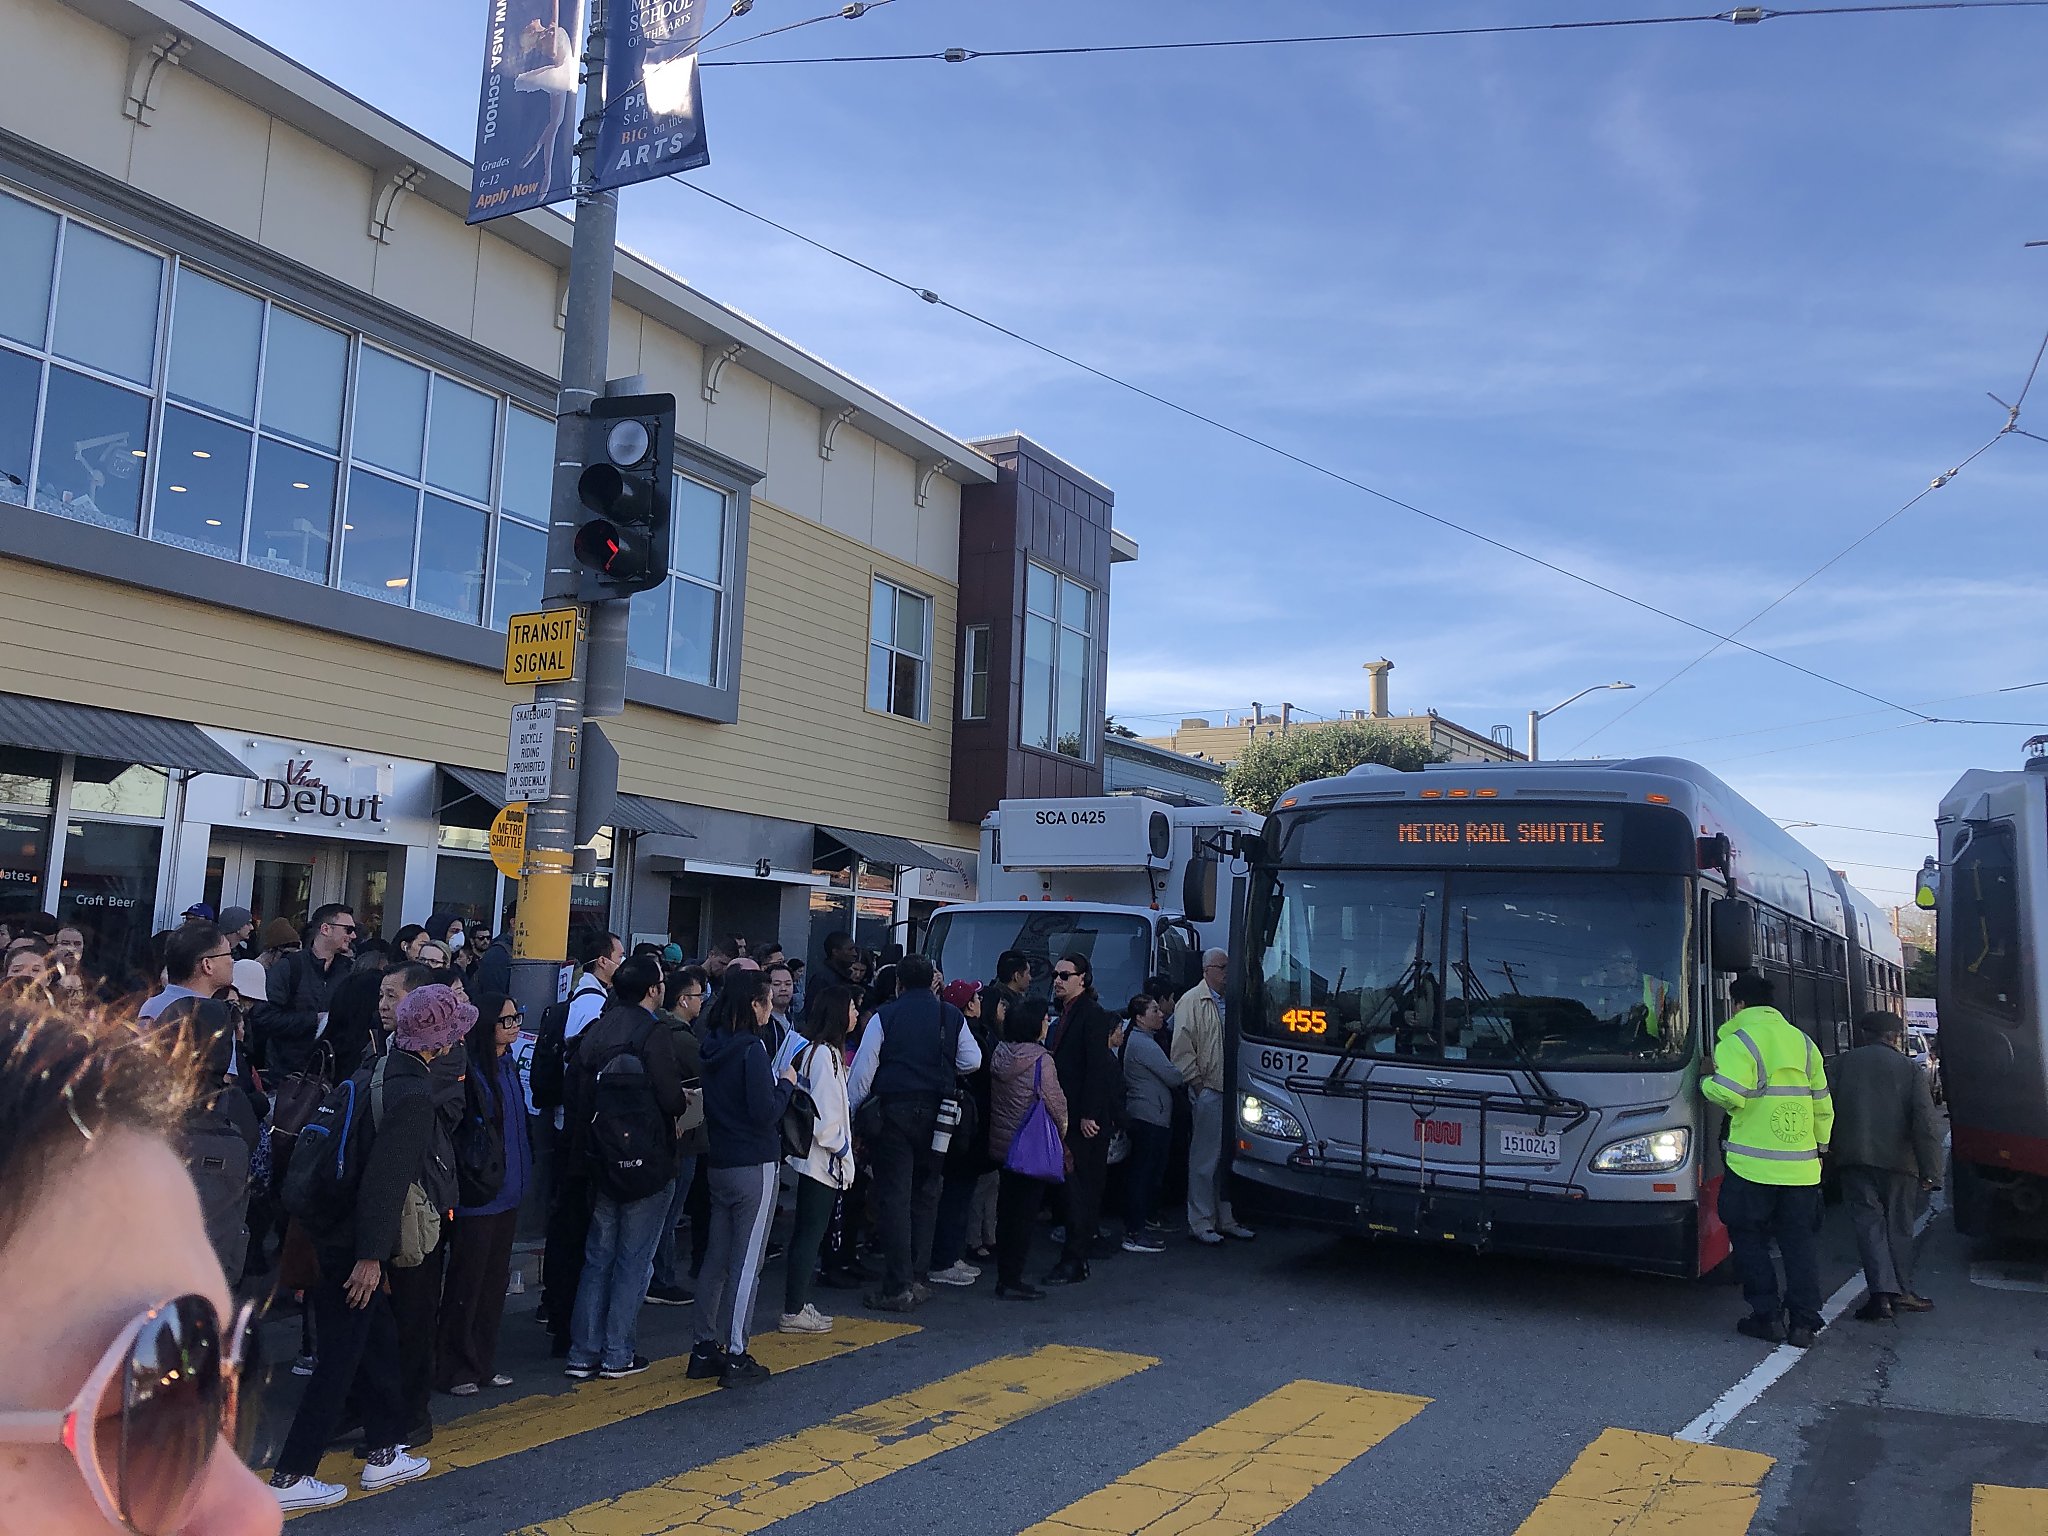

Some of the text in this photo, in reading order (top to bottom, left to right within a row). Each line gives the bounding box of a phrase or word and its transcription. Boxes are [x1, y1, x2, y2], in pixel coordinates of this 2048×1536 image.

[628, 12, 691, 48] OF THE ARTS
[621, 127, 648, 145] BIG
[653, 123, 665, 135] on
[616, 132, 684, 171] ARTS
[481, 156, 511, 172] Grades
[475, 181, 539, 209] Apply Now
[514, 620, 572, 645] TRANSIT
[514, 650, 565, 674] SIGNAL
[516, 708, 552, 722] SKATEBOARD
[520, 732, 543, 745] BICYCLE
[521, 747, 540, 759] RIDING
[513, 761, 546, 773] PROHIBITED
[509, 775, 547, 788] ON SIDEWALK
[263, 779, 383, 823] Debut
[1036, 811, 1106, 825] SCA 0425
[497, 822, 522, 836] METRO
[1399, 823, 1604, 842] METRO RAIL SHUTTLE
[491, 834, 522, 849] SHUTTLE
[76, 894, 135, 908] Craft Beer
[1282, 1009, 1327, 1034] 455
[1261, 1050, 1309, 1073] 6612
[1504, 1136, 1556, 1155] 1510243
[618, 1159, 643, 1168] TIBCO
